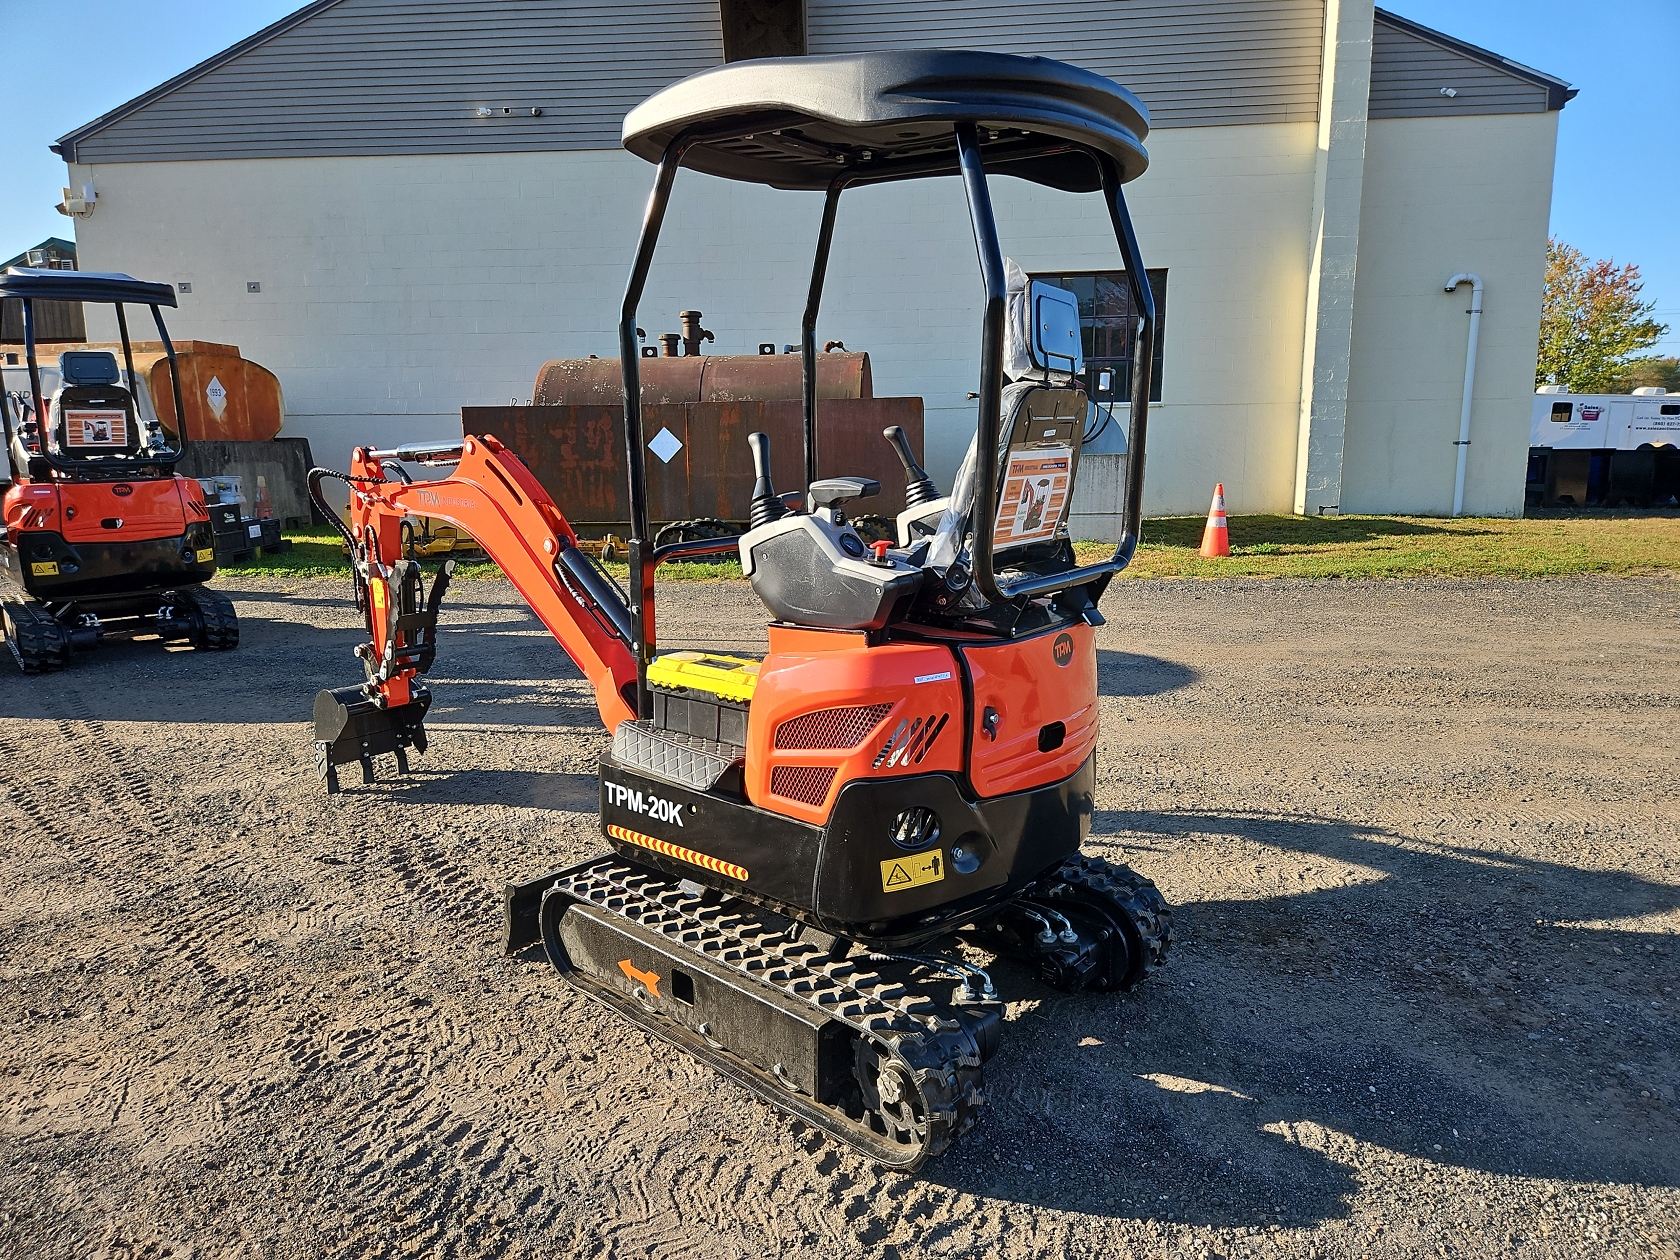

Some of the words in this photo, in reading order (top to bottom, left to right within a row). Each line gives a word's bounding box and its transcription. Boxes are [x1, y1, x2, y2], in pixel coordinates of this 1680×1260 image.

[209, 388, 222, 397] 1993
[416, 490, 441, 508] TPM
[441, 496, 479, 510] INDUSTRIAL
[1055, 641, 1071, 658] TPM
[604, 781, 684, 828] TPM-20K
